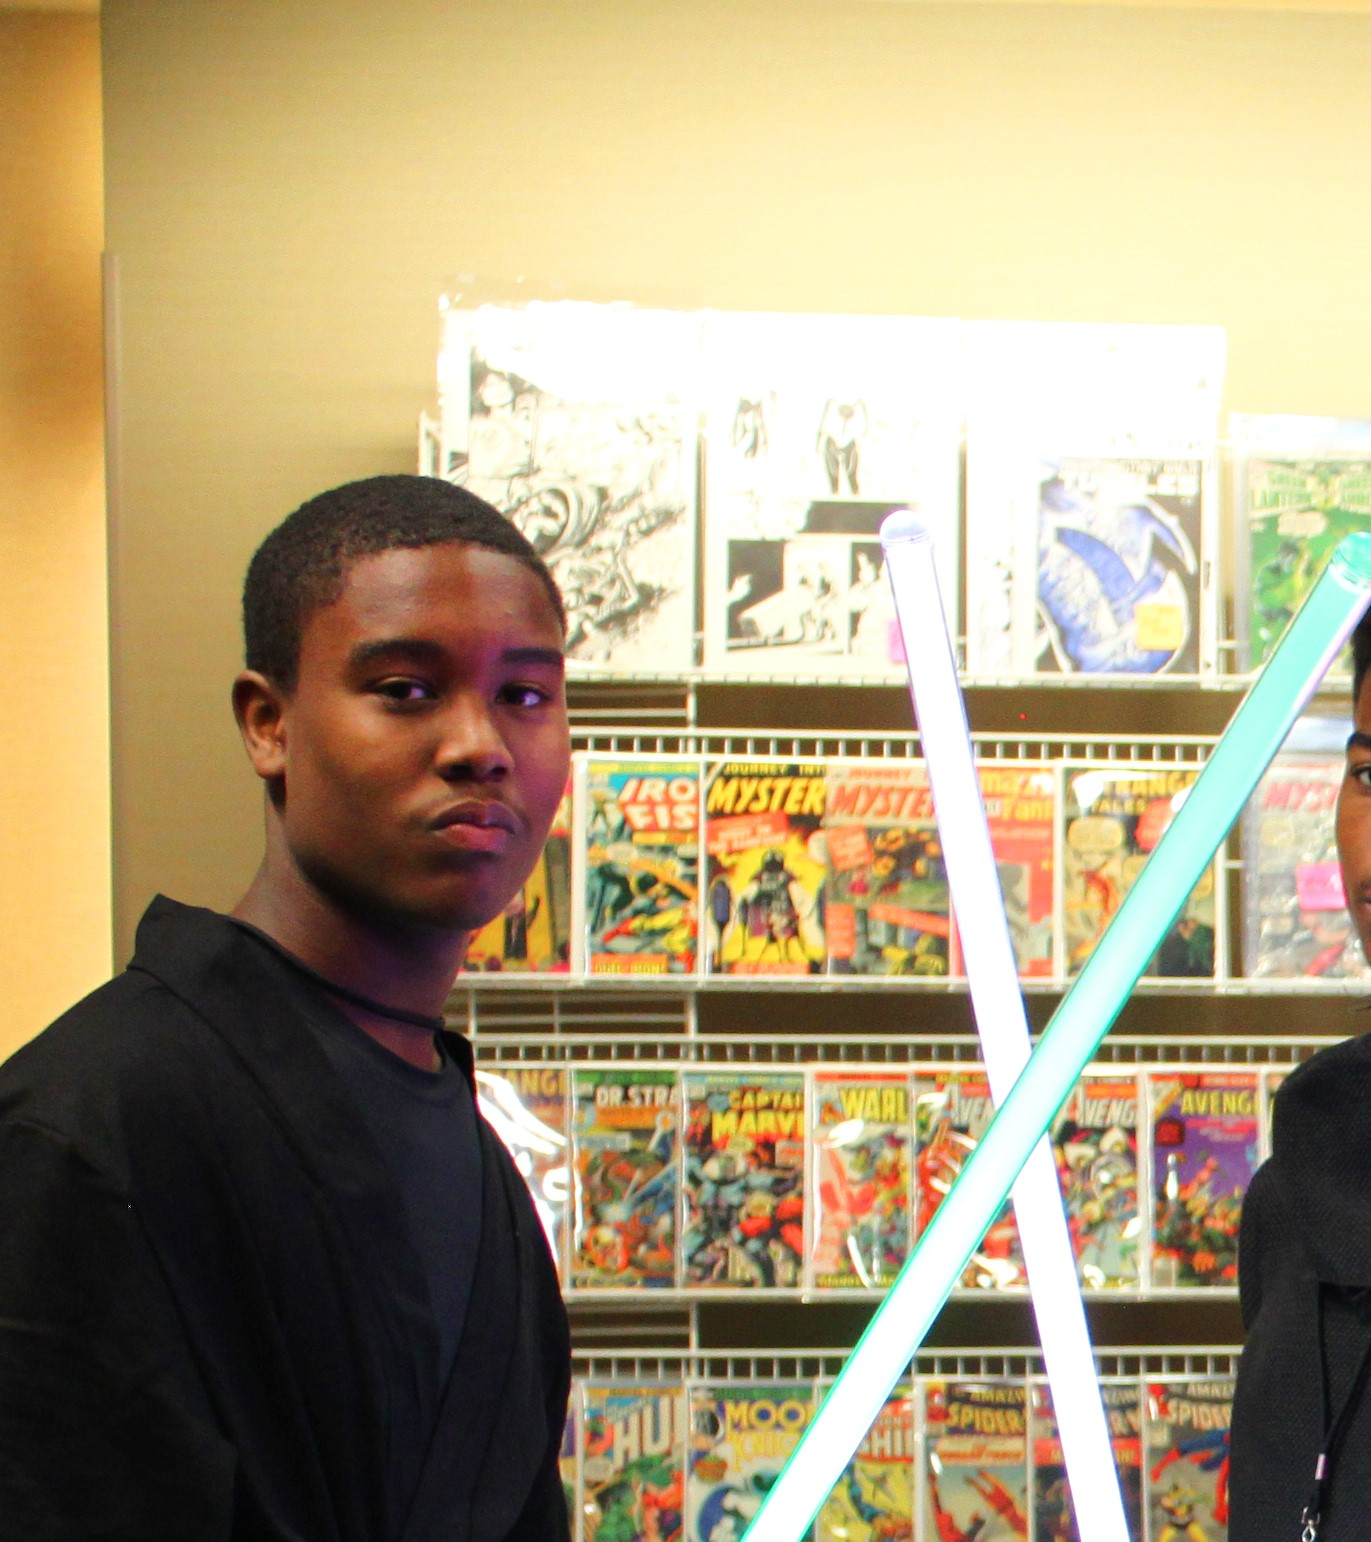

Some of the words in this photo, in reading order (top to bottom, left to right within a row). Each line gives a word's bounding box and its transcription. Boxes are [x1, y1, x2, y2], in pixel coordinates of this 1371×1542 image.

[619, 777, 698, 802] IRO
[706, 776, 826, 815] MYSTER
[832, 784, 936, 818] MYSTE
[626, 802, 698, 832] FIS
[627, 1085, 682, 1108] STRA
[947, 1402, 1027, 1434] SPIDER
